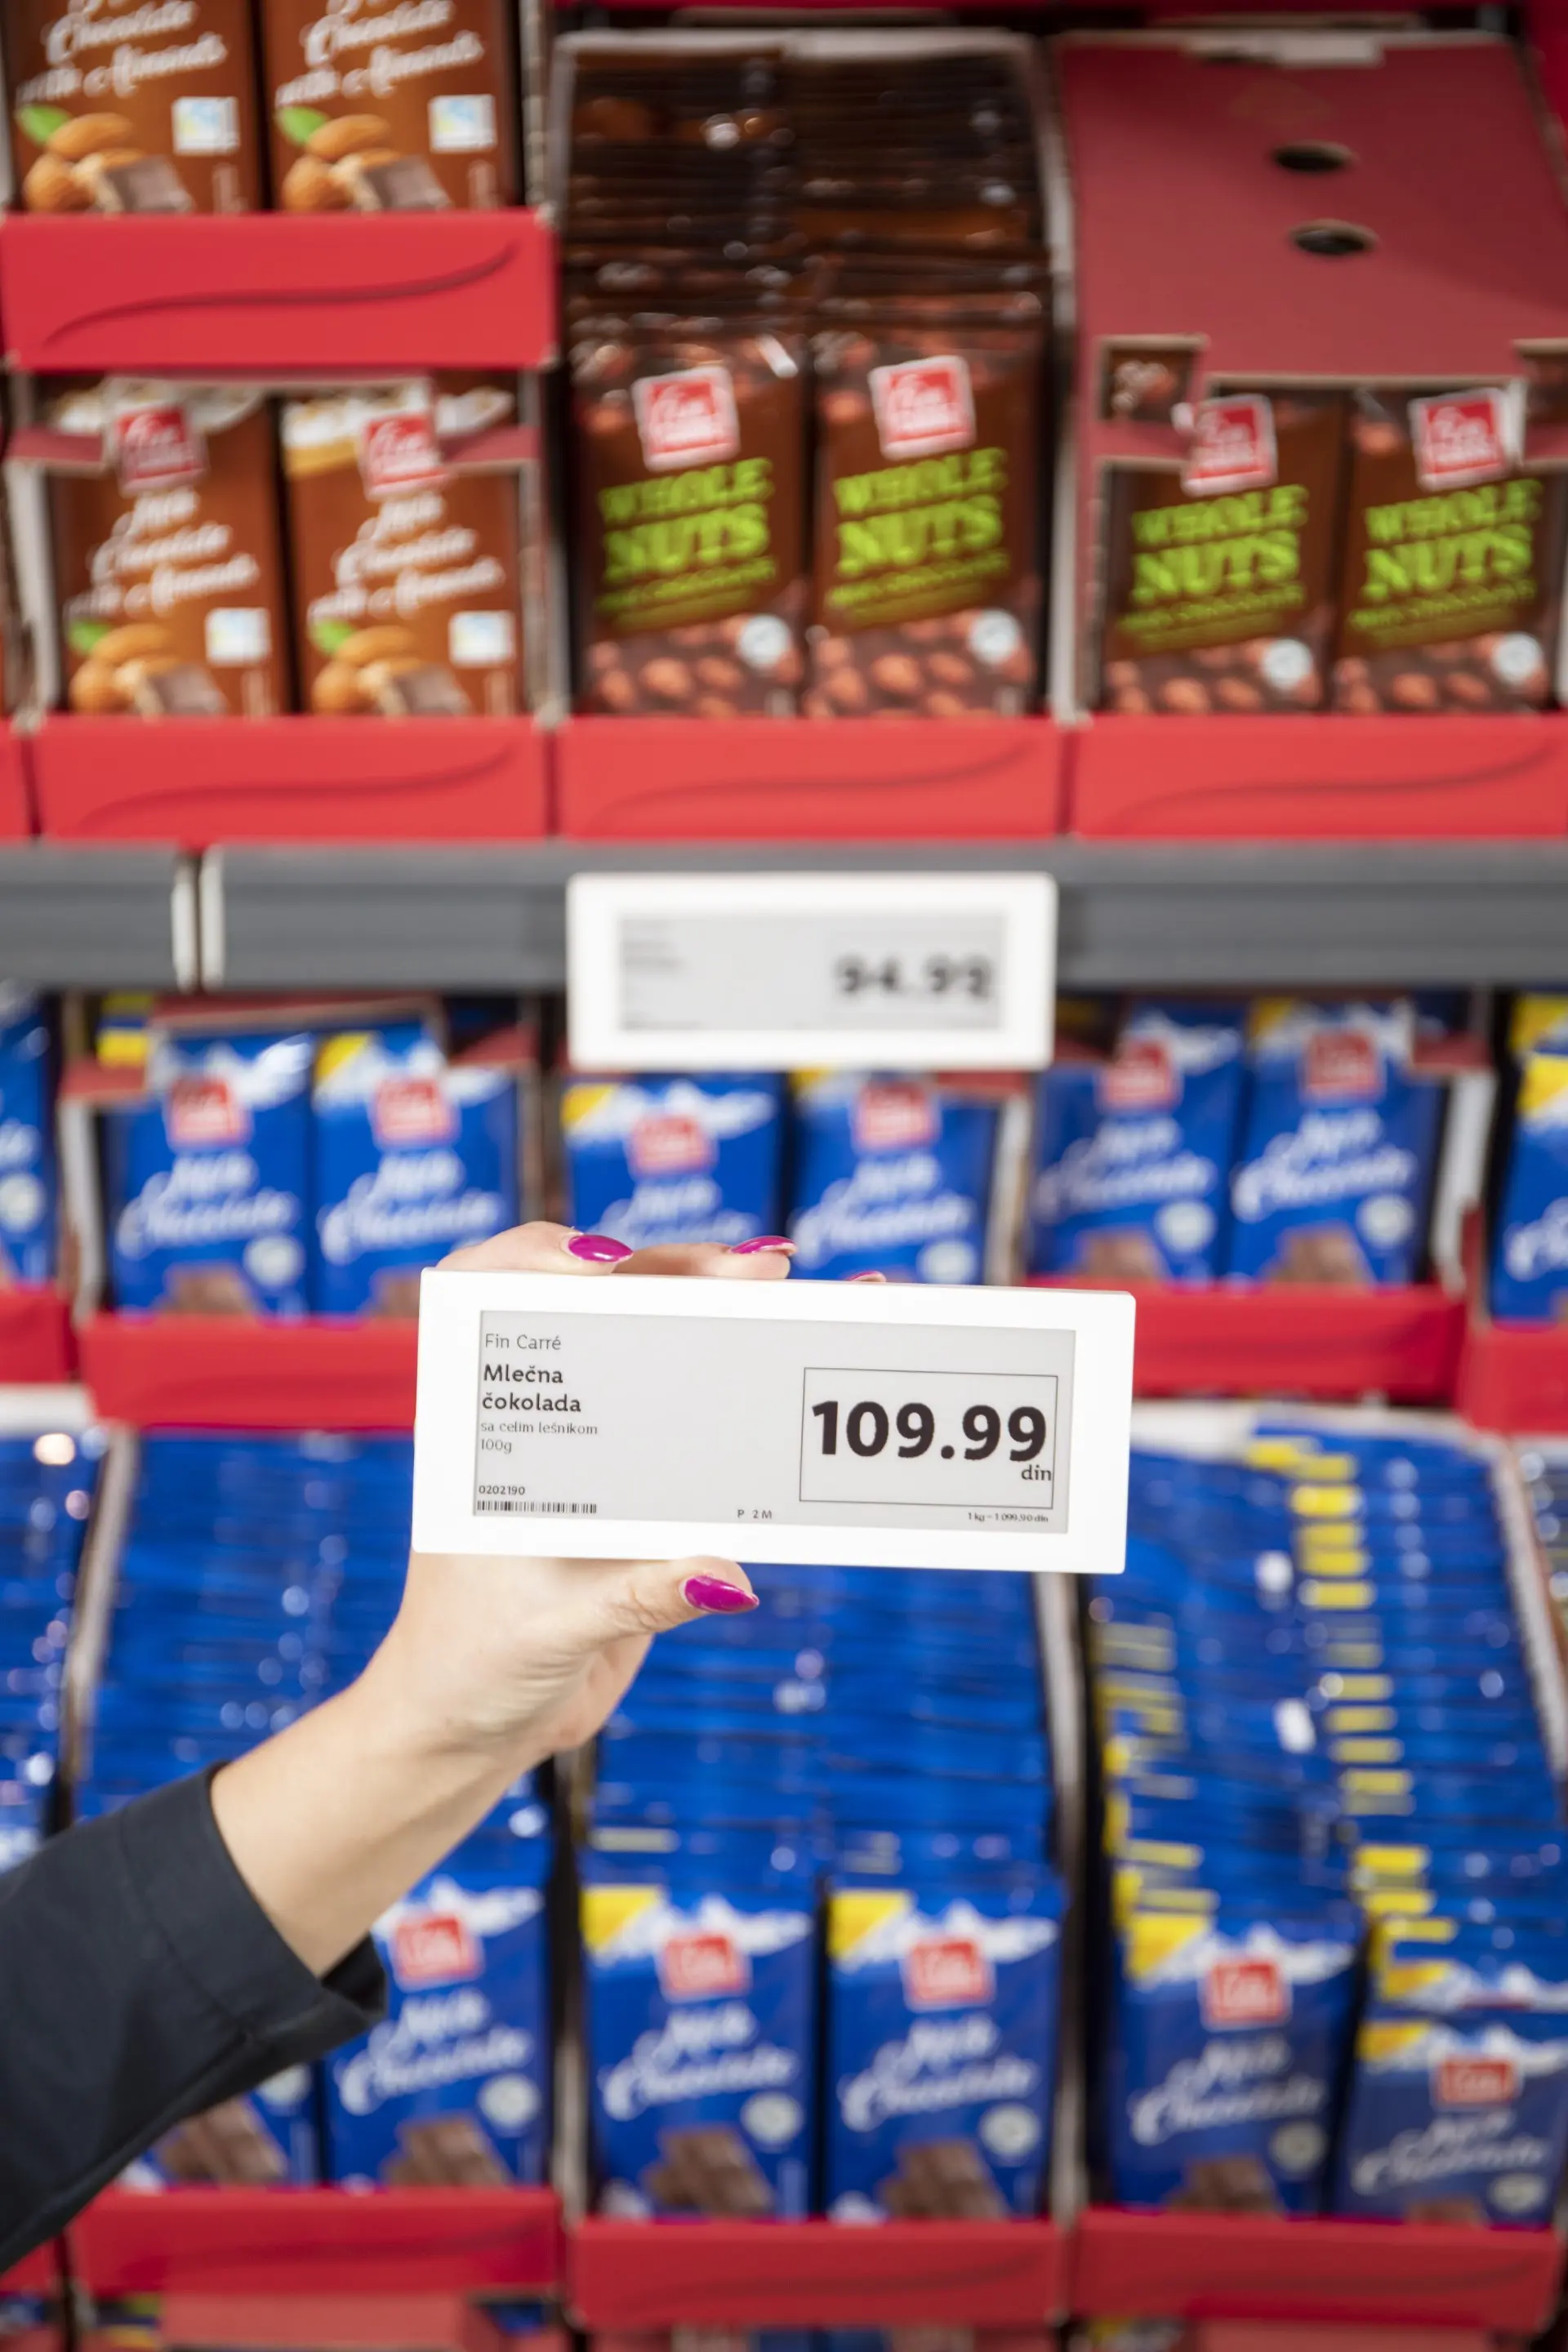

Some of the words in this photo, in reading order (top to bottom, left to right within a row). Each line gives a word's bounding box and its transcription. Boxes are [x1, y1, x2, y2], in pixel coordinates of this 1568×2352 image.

[485, 1333, 510, 1348] Fin
[516, 1334, 562, 1350] Carré
[483, 1363, 564, 1383] Mlečna
[482, 1392, 581, 1412] čokolada
[480, 1422, 495, 1432] sa
[499, 1421, 534, 1433] celim
[538, 1421, 598, 1435] lešnikom
[812, 1401, 1046, 1462] 109.99
[481, 1438, 512, 1454] 100g
[1021, 1464, 1052, 1481] din
[479, 1485, 526, 1495] 0202190
